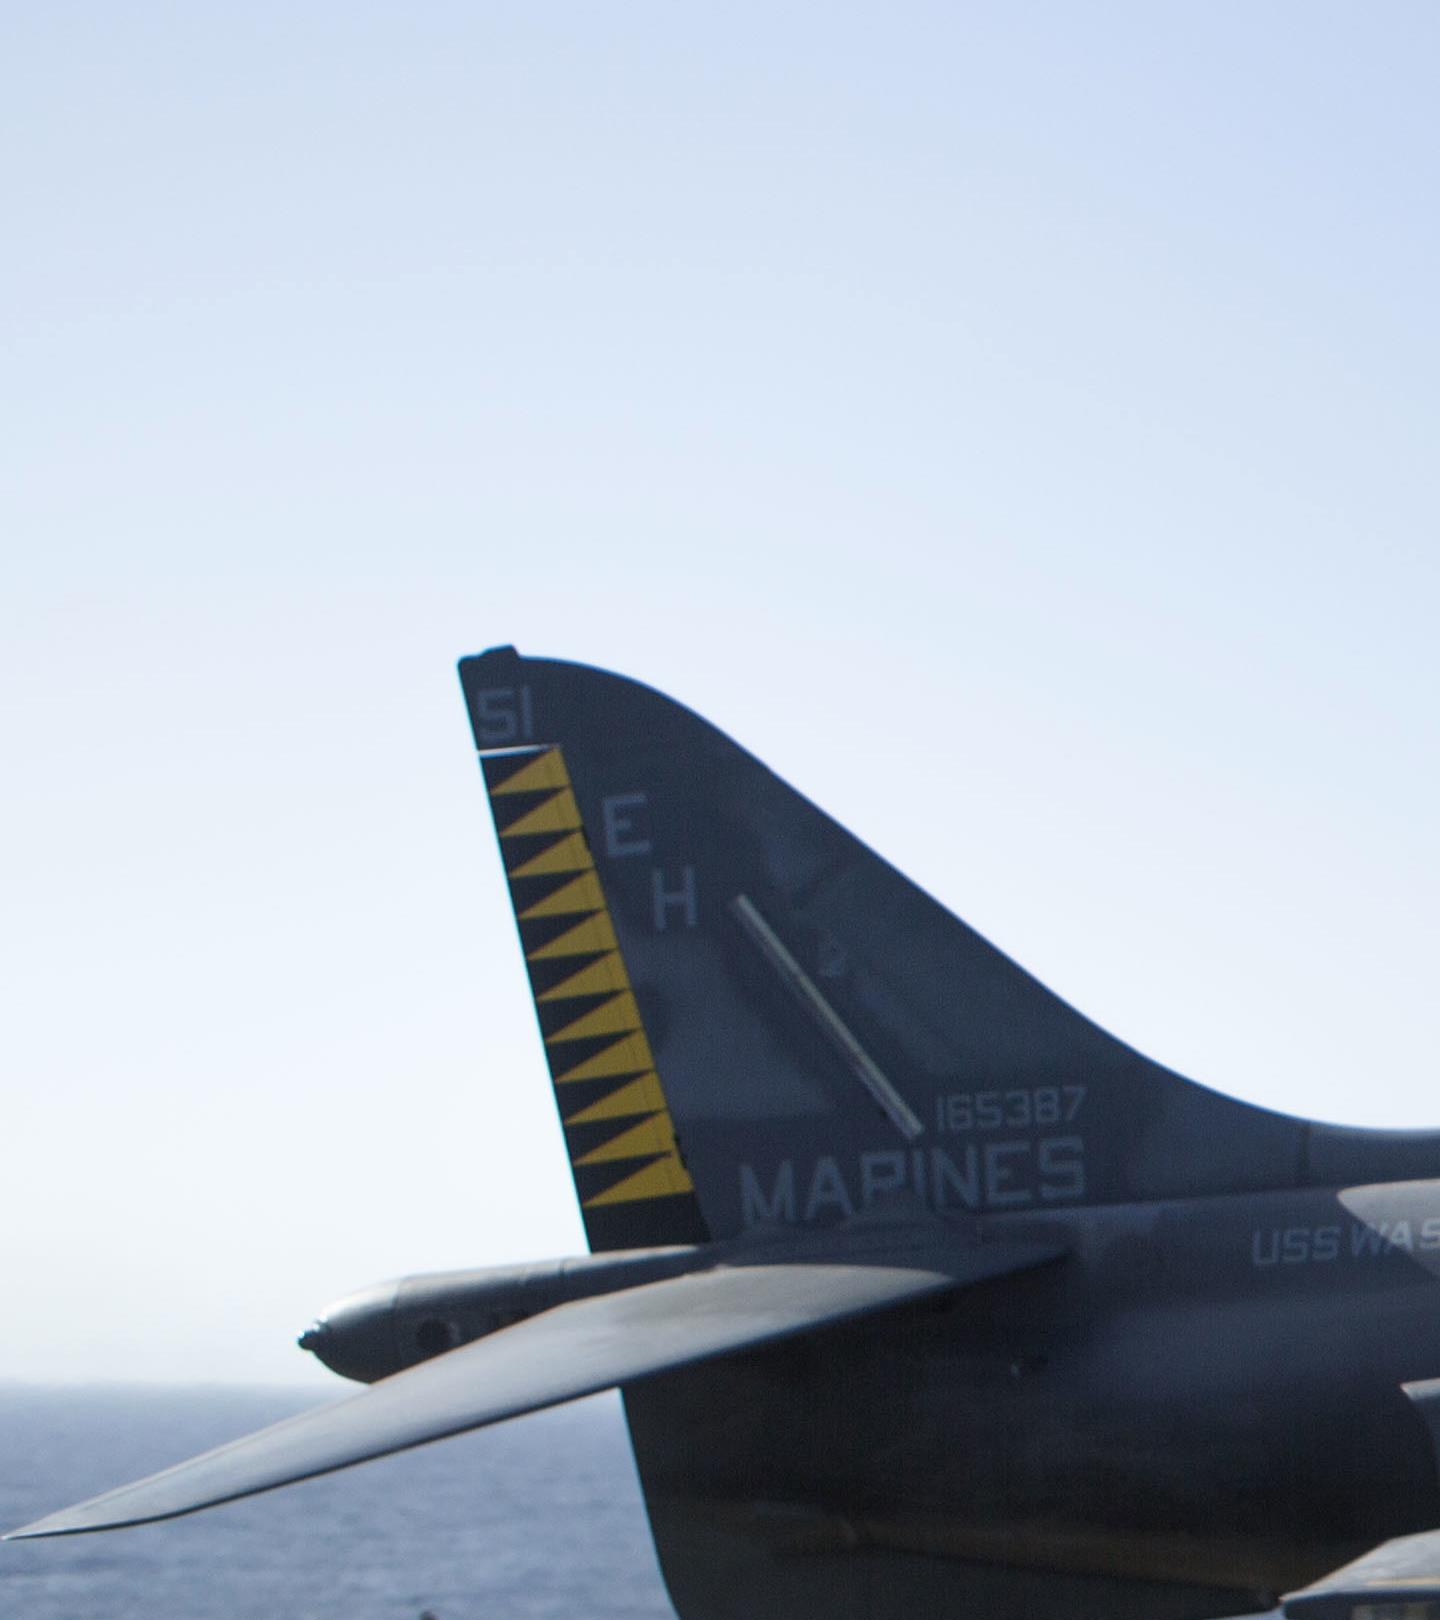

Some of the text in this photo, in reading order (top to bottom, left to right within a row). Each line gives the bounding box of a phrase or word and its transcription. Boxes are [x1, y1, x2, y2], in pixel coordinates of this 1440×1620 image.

[476, 685, 533, 741] 51
[601, 792, 652, 859] E
[651, 865, 696, 932] H
[934, 1082, 1088, 1134] 165387
[1252, 1225, 1341, 1266] USS
